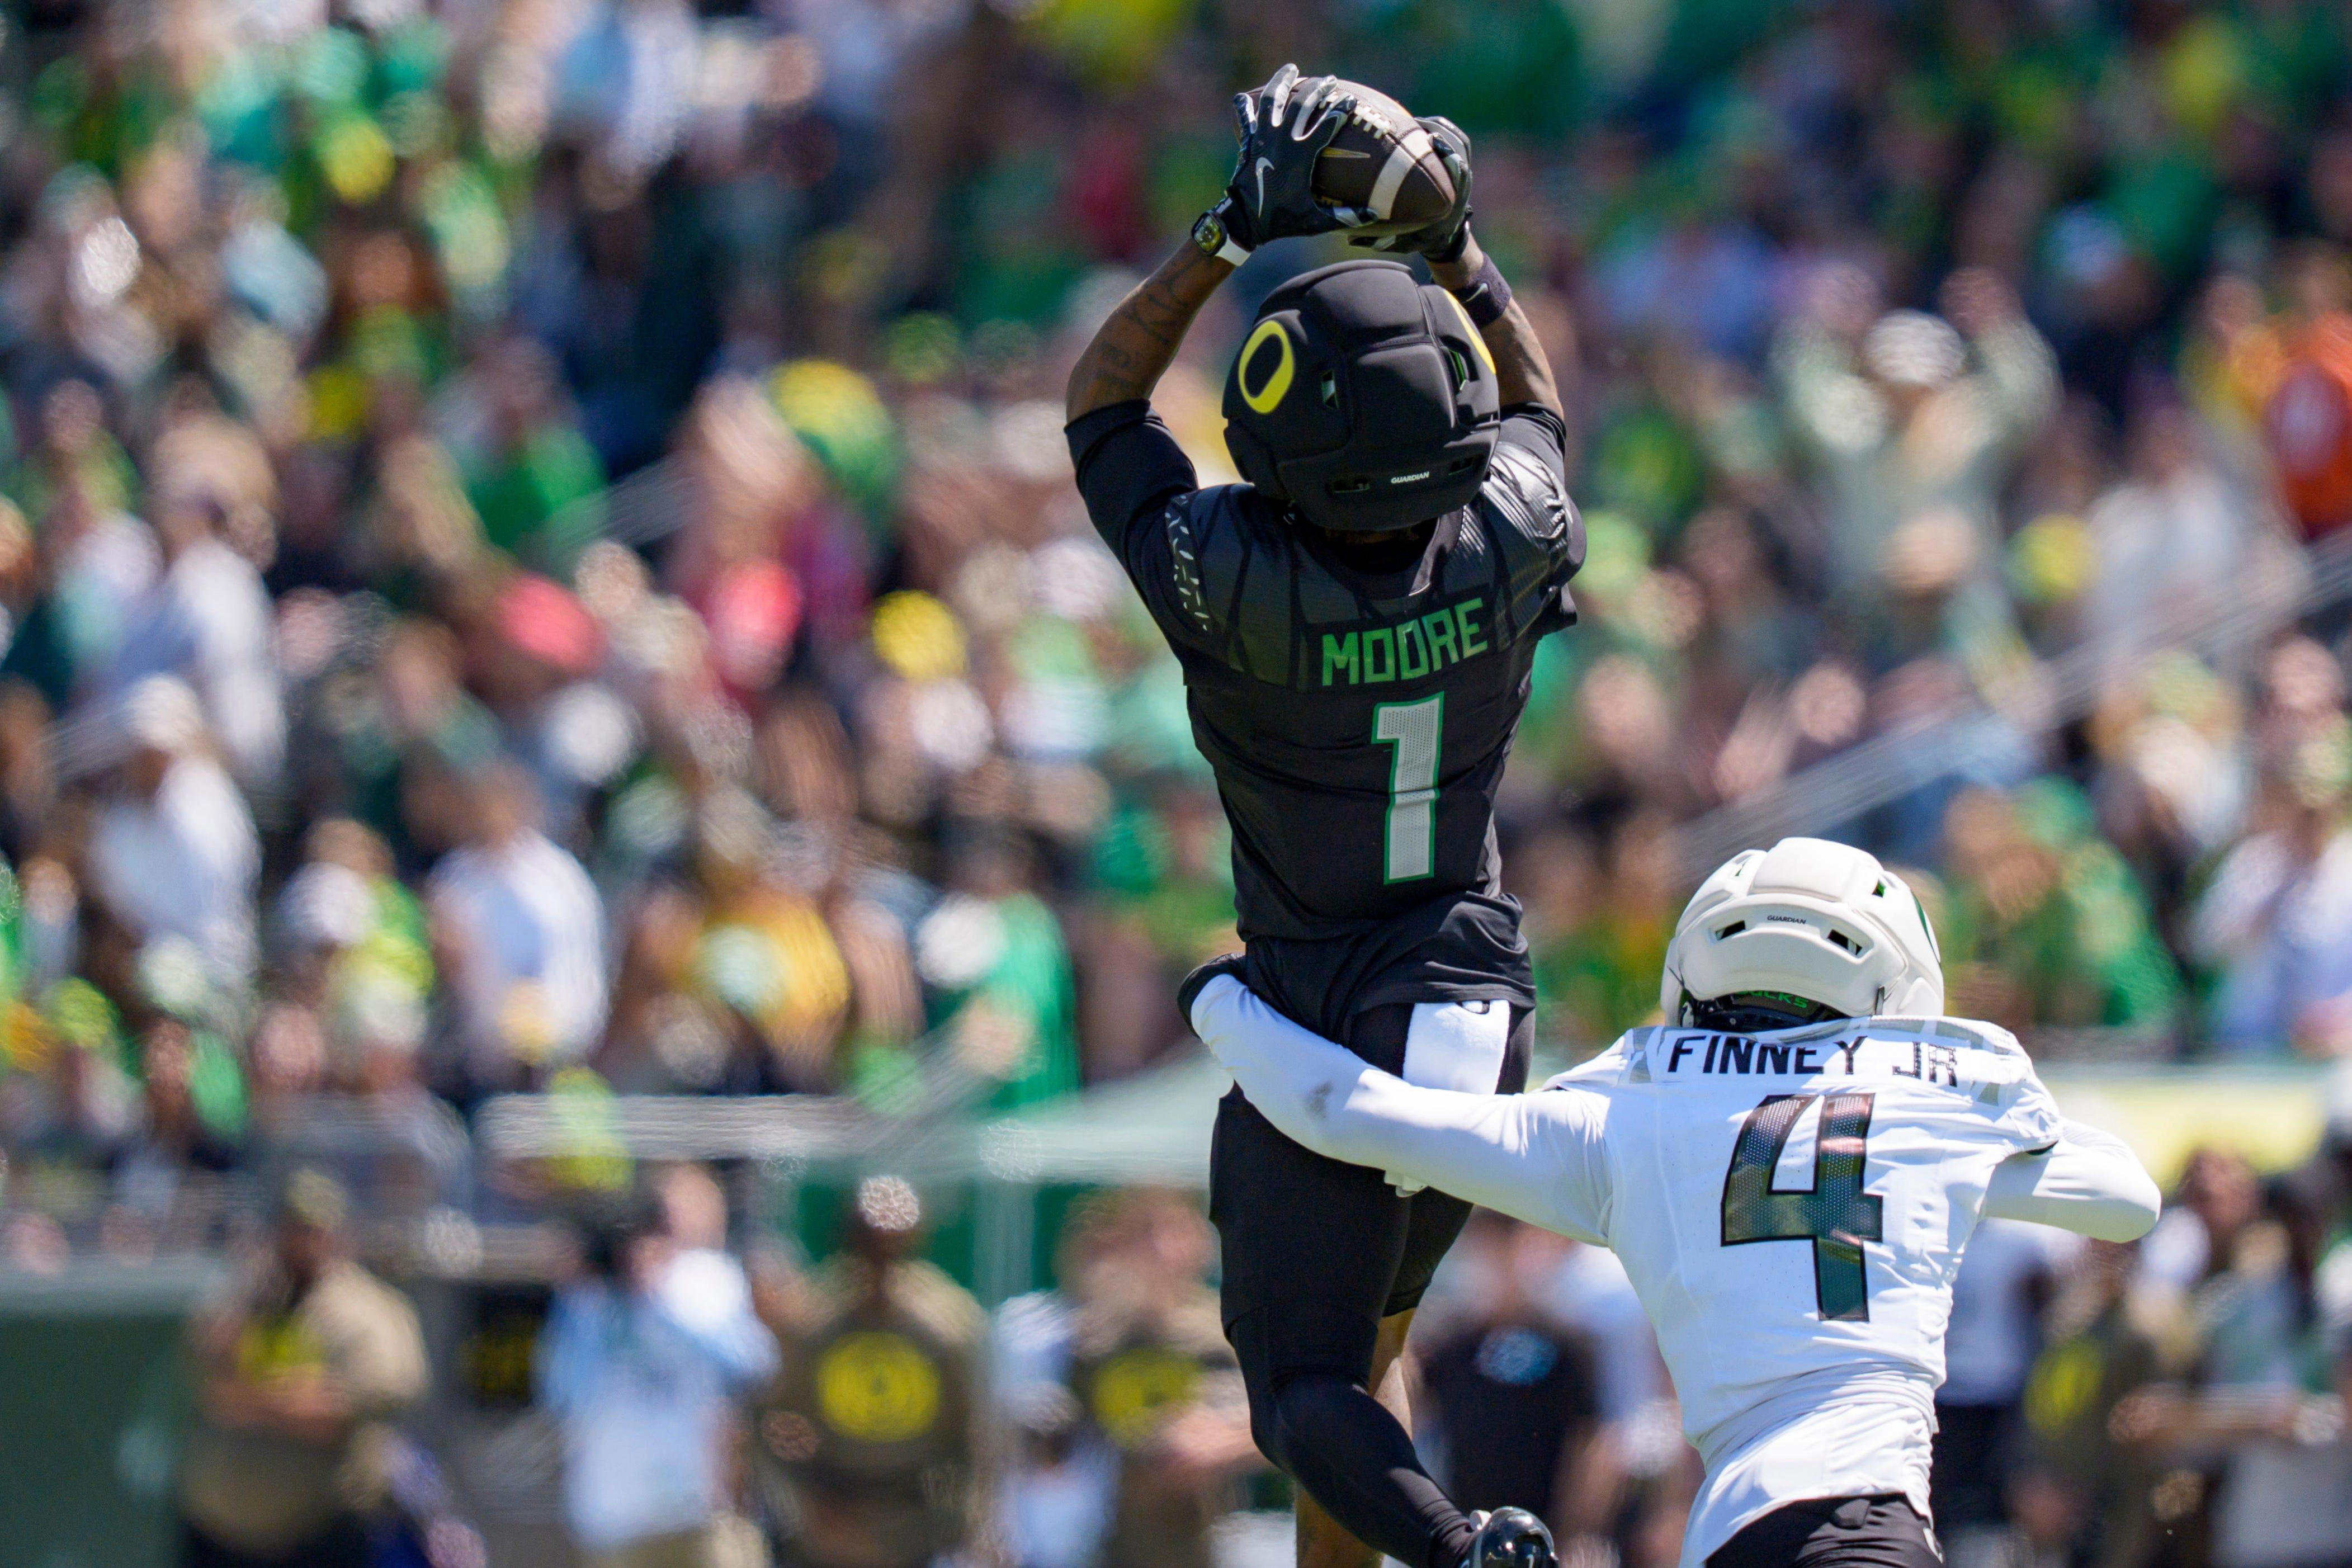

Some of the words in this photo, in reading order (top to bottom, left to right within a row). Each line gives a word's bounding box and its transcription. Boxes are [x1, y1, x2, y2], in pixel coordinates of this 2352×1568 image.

[1391, 471, 1430, 484] GUARDIAN
[1321, 597, 1488, 687] MOORE
[1371, 690, 1445, 886] 1
[1767, 915, 1806, 924] GUARDIAN
[1739, 990, 1808, 1008] UCKS
[1668, 1035, 1868, 1075] FINNEY
[1892, 1041, 1958, 1087] JR
[1721, 1092, 1883, 1322] 4
